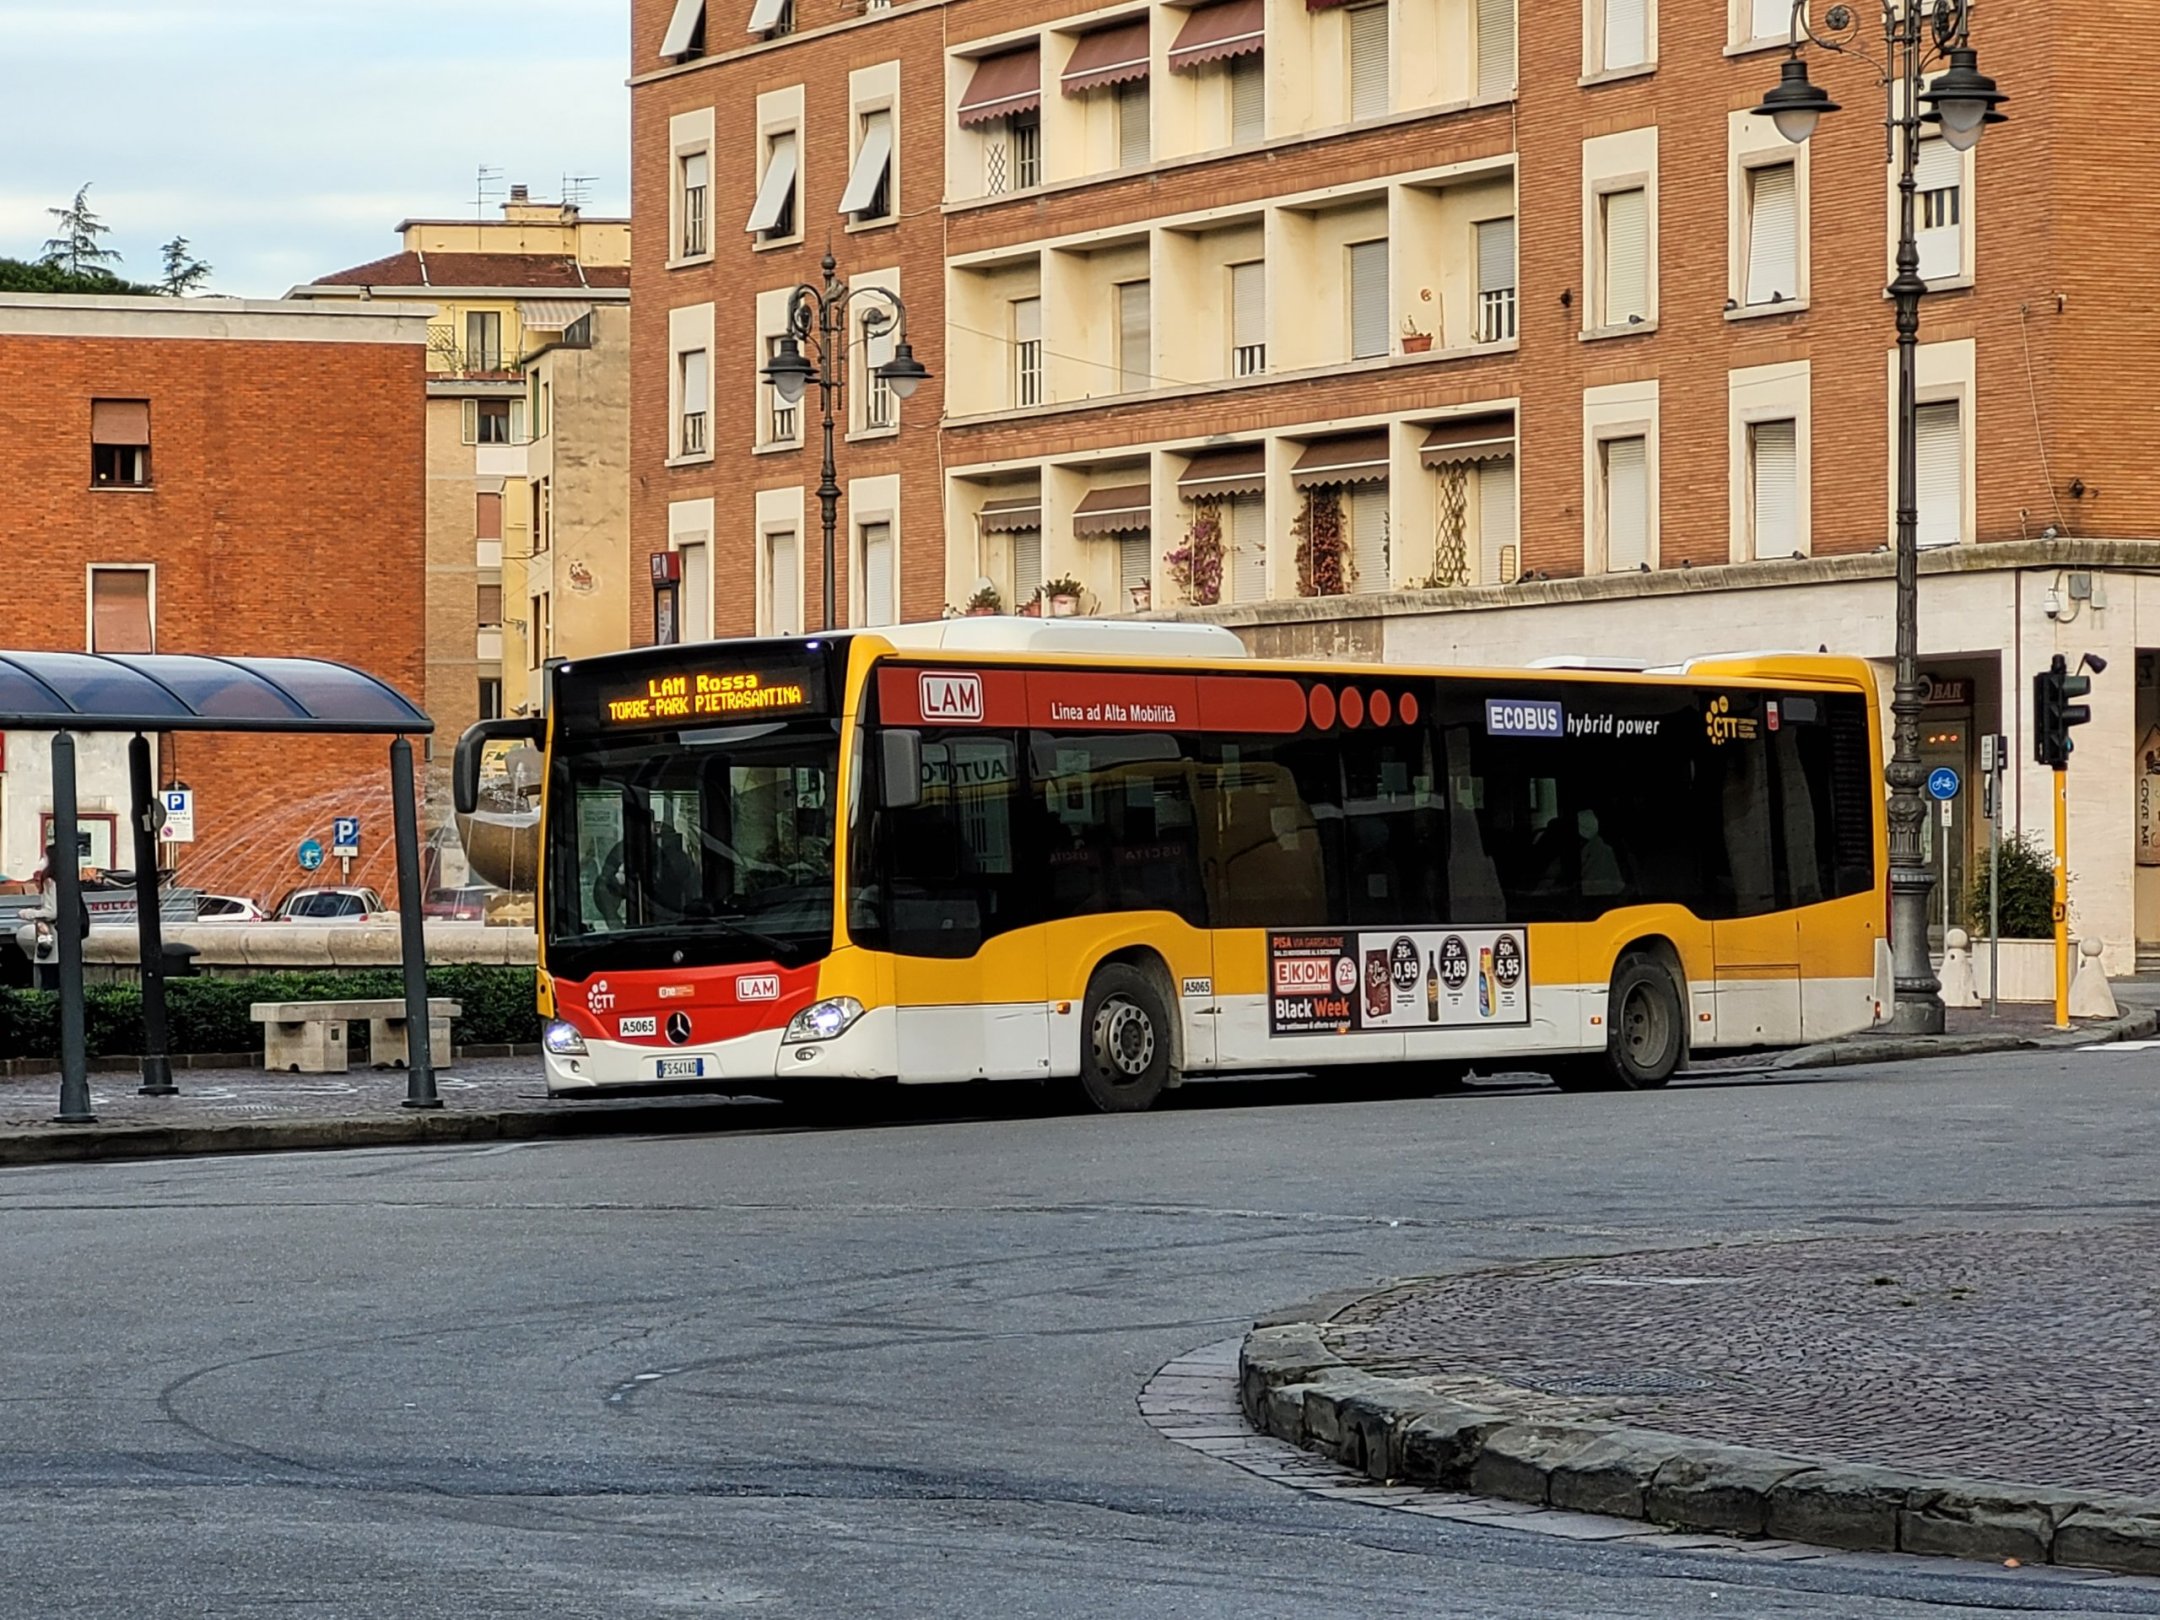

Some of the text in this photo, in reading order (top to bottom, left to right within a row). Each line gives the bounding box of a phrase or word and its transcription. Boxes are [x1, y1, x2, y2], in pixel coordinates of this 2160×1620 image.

[649, 674, 758, 697] LAM Rossa
[1933, 682, 1962, 699] BAR
[608, 685, 802, 721] TORRE-PARK PIETRASANTINA
[926, 682, 976, 713] LAM
[1052, 702, 1176, 723] Linea ad Alta Mobilità
[1490, 706, 1660, 738] ECOBUS hybrid power
[1714, 717, 1738, 738] CTT
[170, 794, 182, 809] P
[338, 820, 353, 843] P
[1279, 963, 1329, 981] EKOM
[740, 977, 775, 998] LAM
[1184, 981, 1210, 993] A5065
[593, 994, 616, 1011] CTT
[1275, 998, 1350, 1019] Black Week
[622, 1020, 655, 1033] A5065
